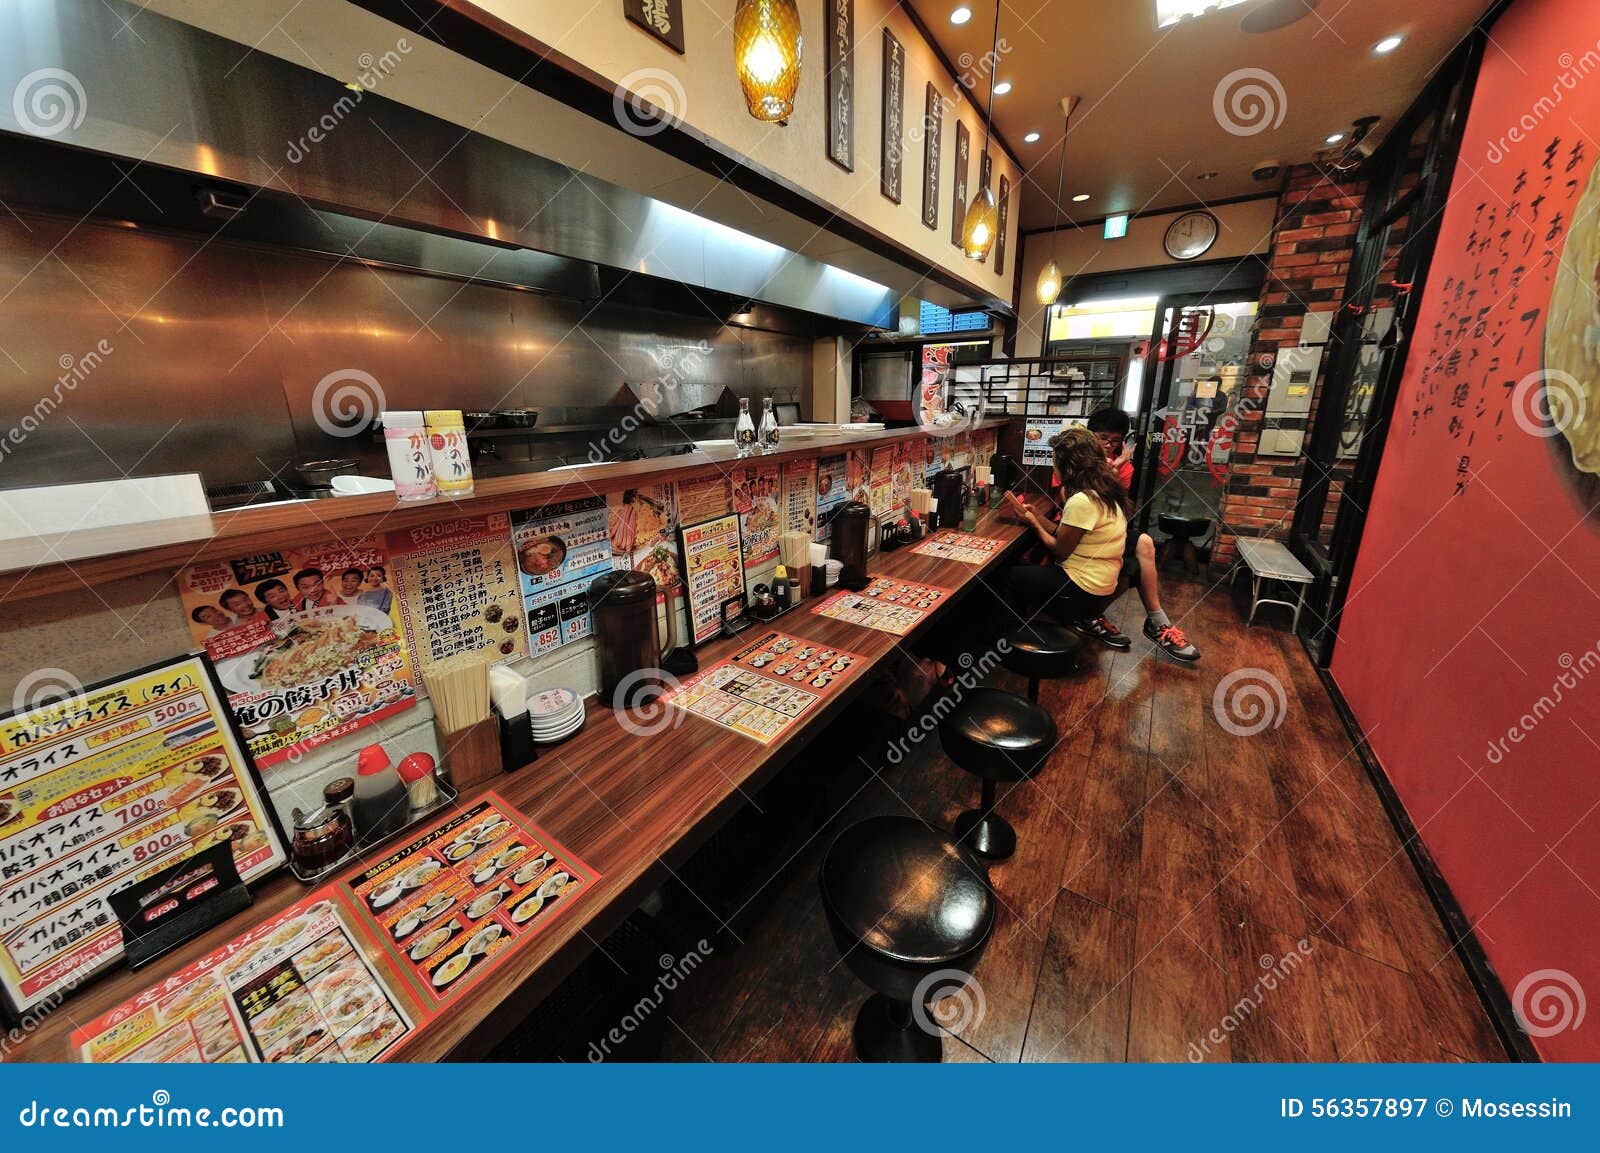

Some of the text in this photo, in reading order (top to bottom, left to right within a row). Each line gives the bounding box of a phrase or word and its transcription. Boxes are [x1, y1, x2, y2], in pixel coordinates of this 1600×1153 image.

[417, 548, 481, 569] レバニラ炒め
[417, 556, 483, 578] マーボー豆腐
[419, 560, 502, 587] チンジャオロース
[420, 569, 503, 596] 海老のチリソース
[424, 589, 487, 613] 肉団子の甘酢
[425, 589, 516, 622] 肉団子のチリソース
[427, 609, 481, 631] 肉野菜炒め
[429, 624, 462, 640] 八宝菜
[430, 625, 484, 648] 肉ニラ炒め
[155, 700, 197, 723] 500円
[47, 776, 134, 818] お得なセット
[114, 798, 167, 825] 700円
[132, 832, 183, 863] 800円
[365, 807, 481, 878] 当店オリジナルメニュー
[8, 843, 120, 905] ガパオライス
[20, 911, 115, 969] ハーフ韓国冷麺
